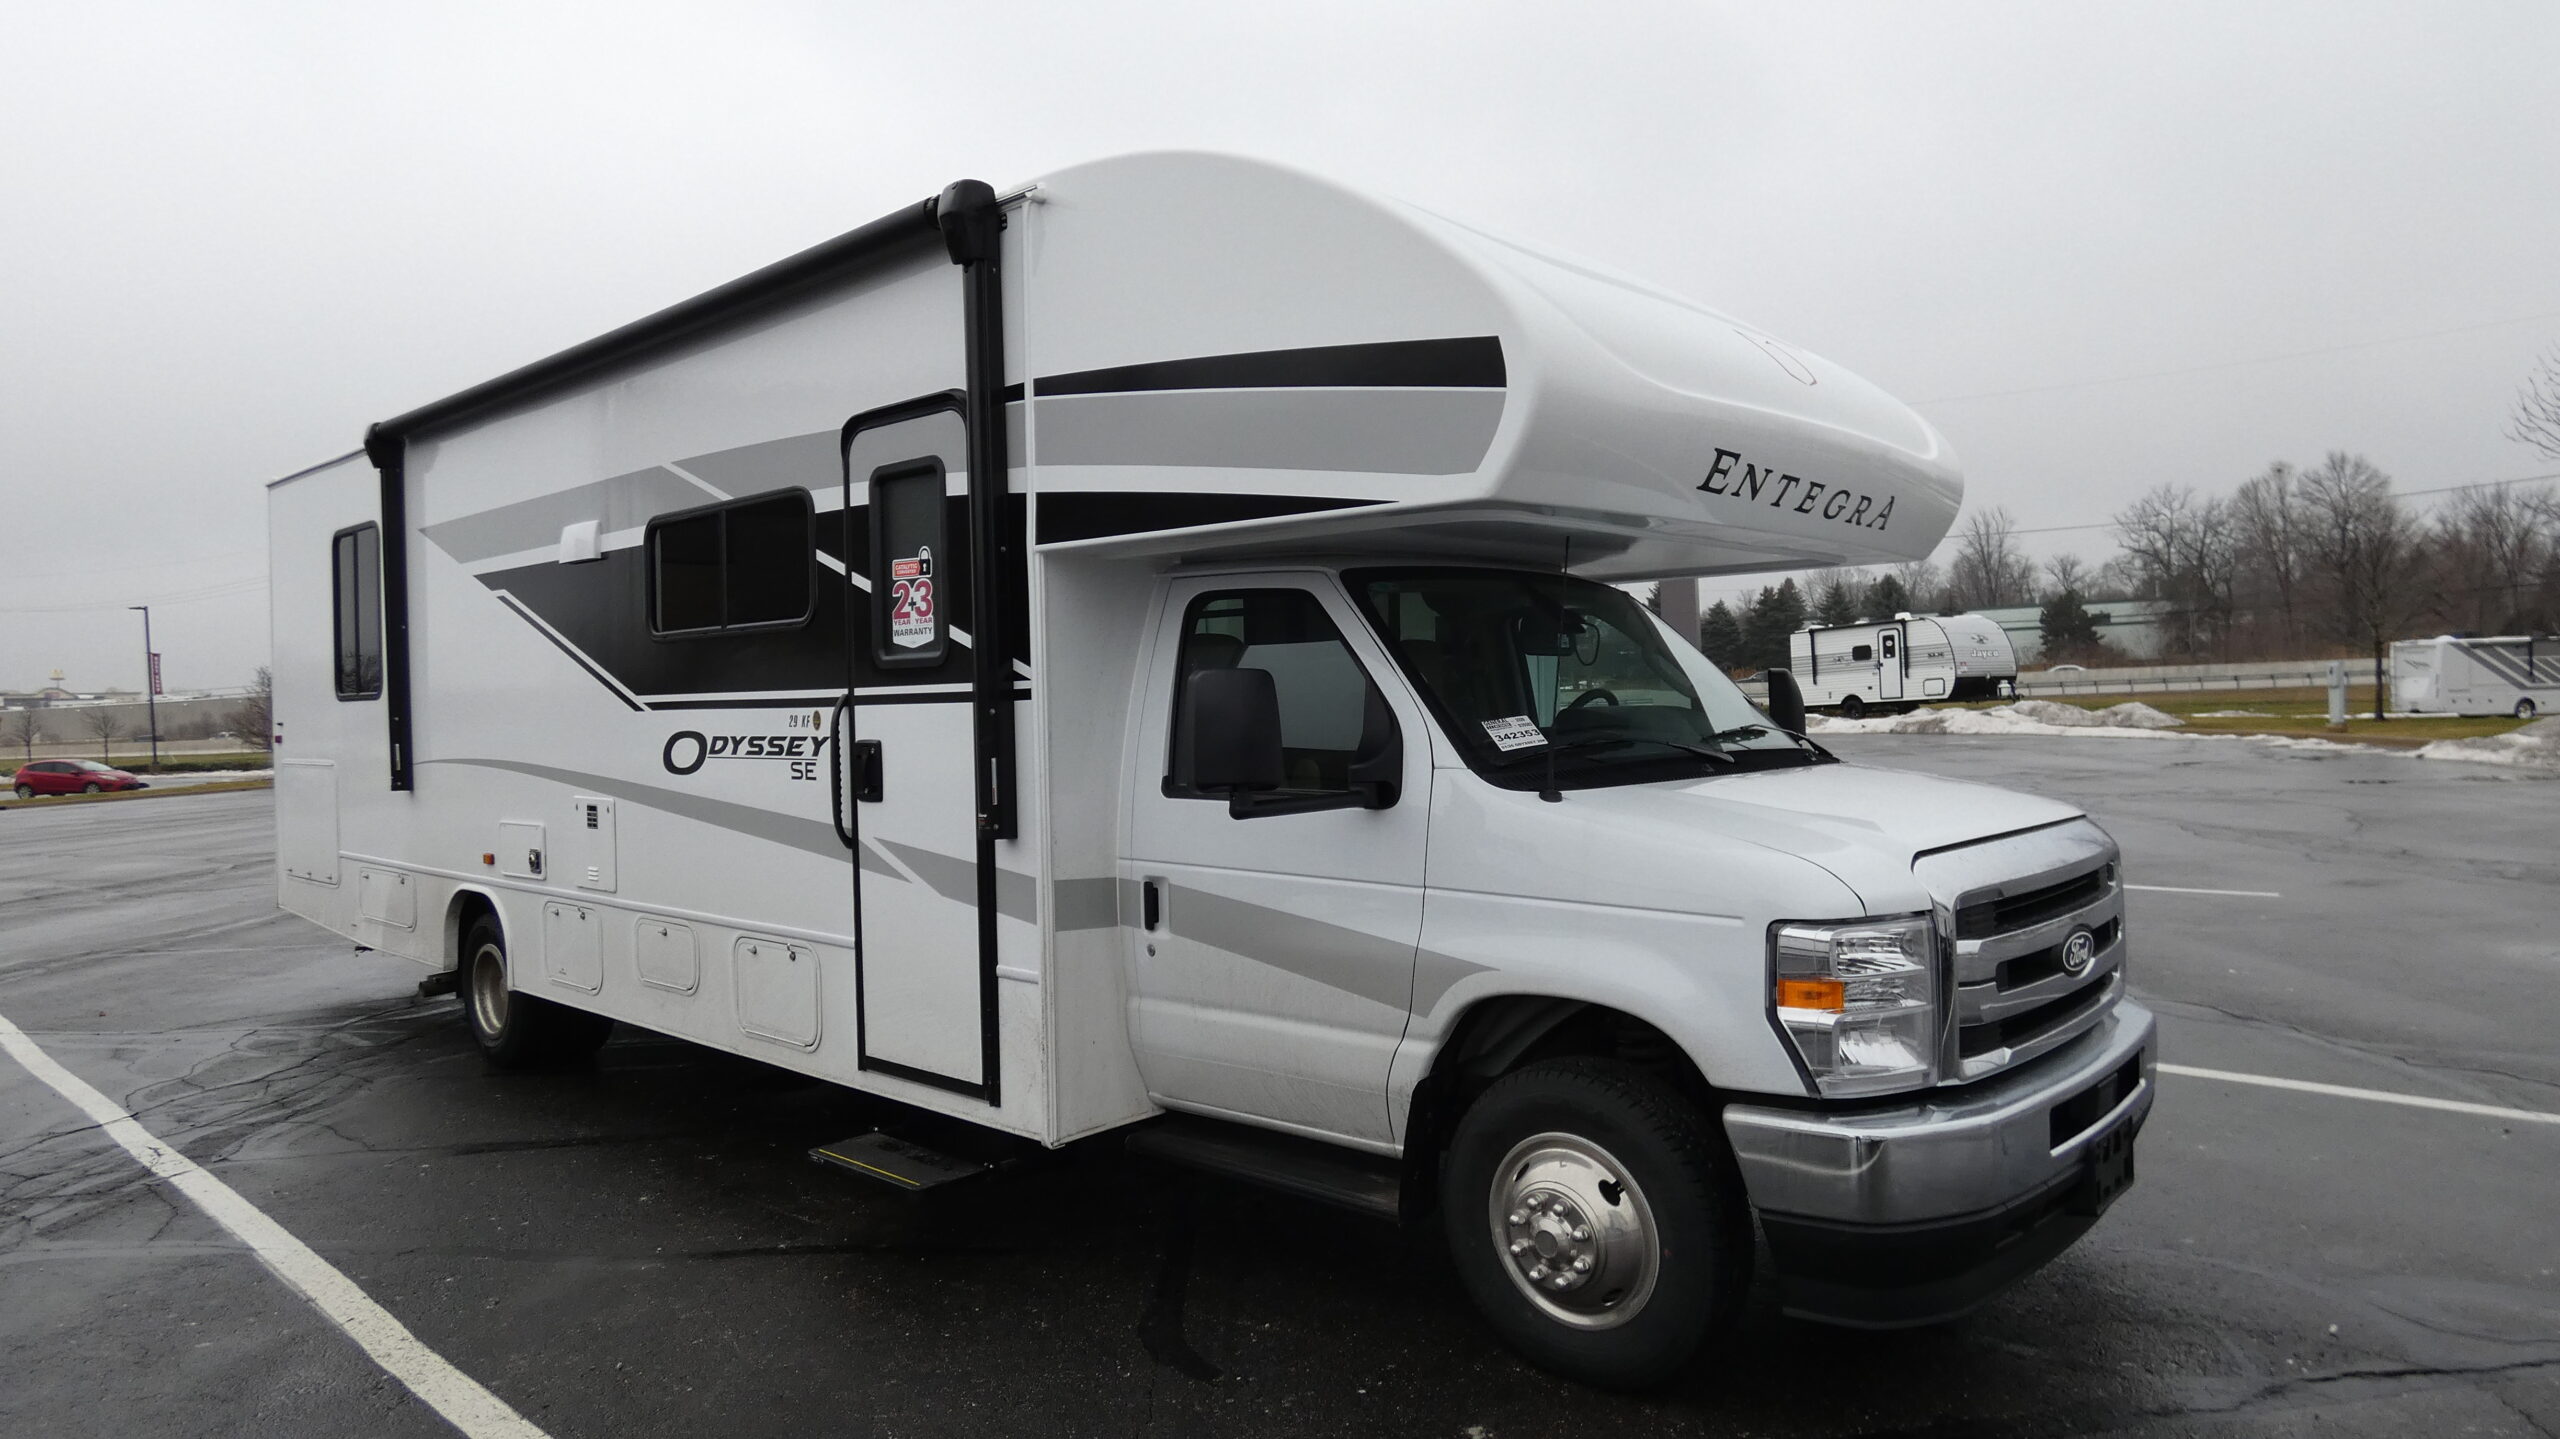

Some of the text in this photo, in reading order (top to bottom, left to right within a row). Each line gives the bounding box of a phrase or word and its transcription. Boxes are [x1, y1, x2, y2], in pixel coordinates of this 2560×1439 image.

[1696, 448, 1896, 531] ENTEGRA
[894, 626, 933, 637] WARRANTY
[1971, 649, 1999, 658] Jayco
[788, 714, 798, 728] 29
[801, 714, 811, 728] KF
[1494, 729, 1540, 742] 342353
[663, 730, 831, 776] ODYSSEY
[790, 761, 818, 781] SE
[2070, 936, 2090, 966] Ford
